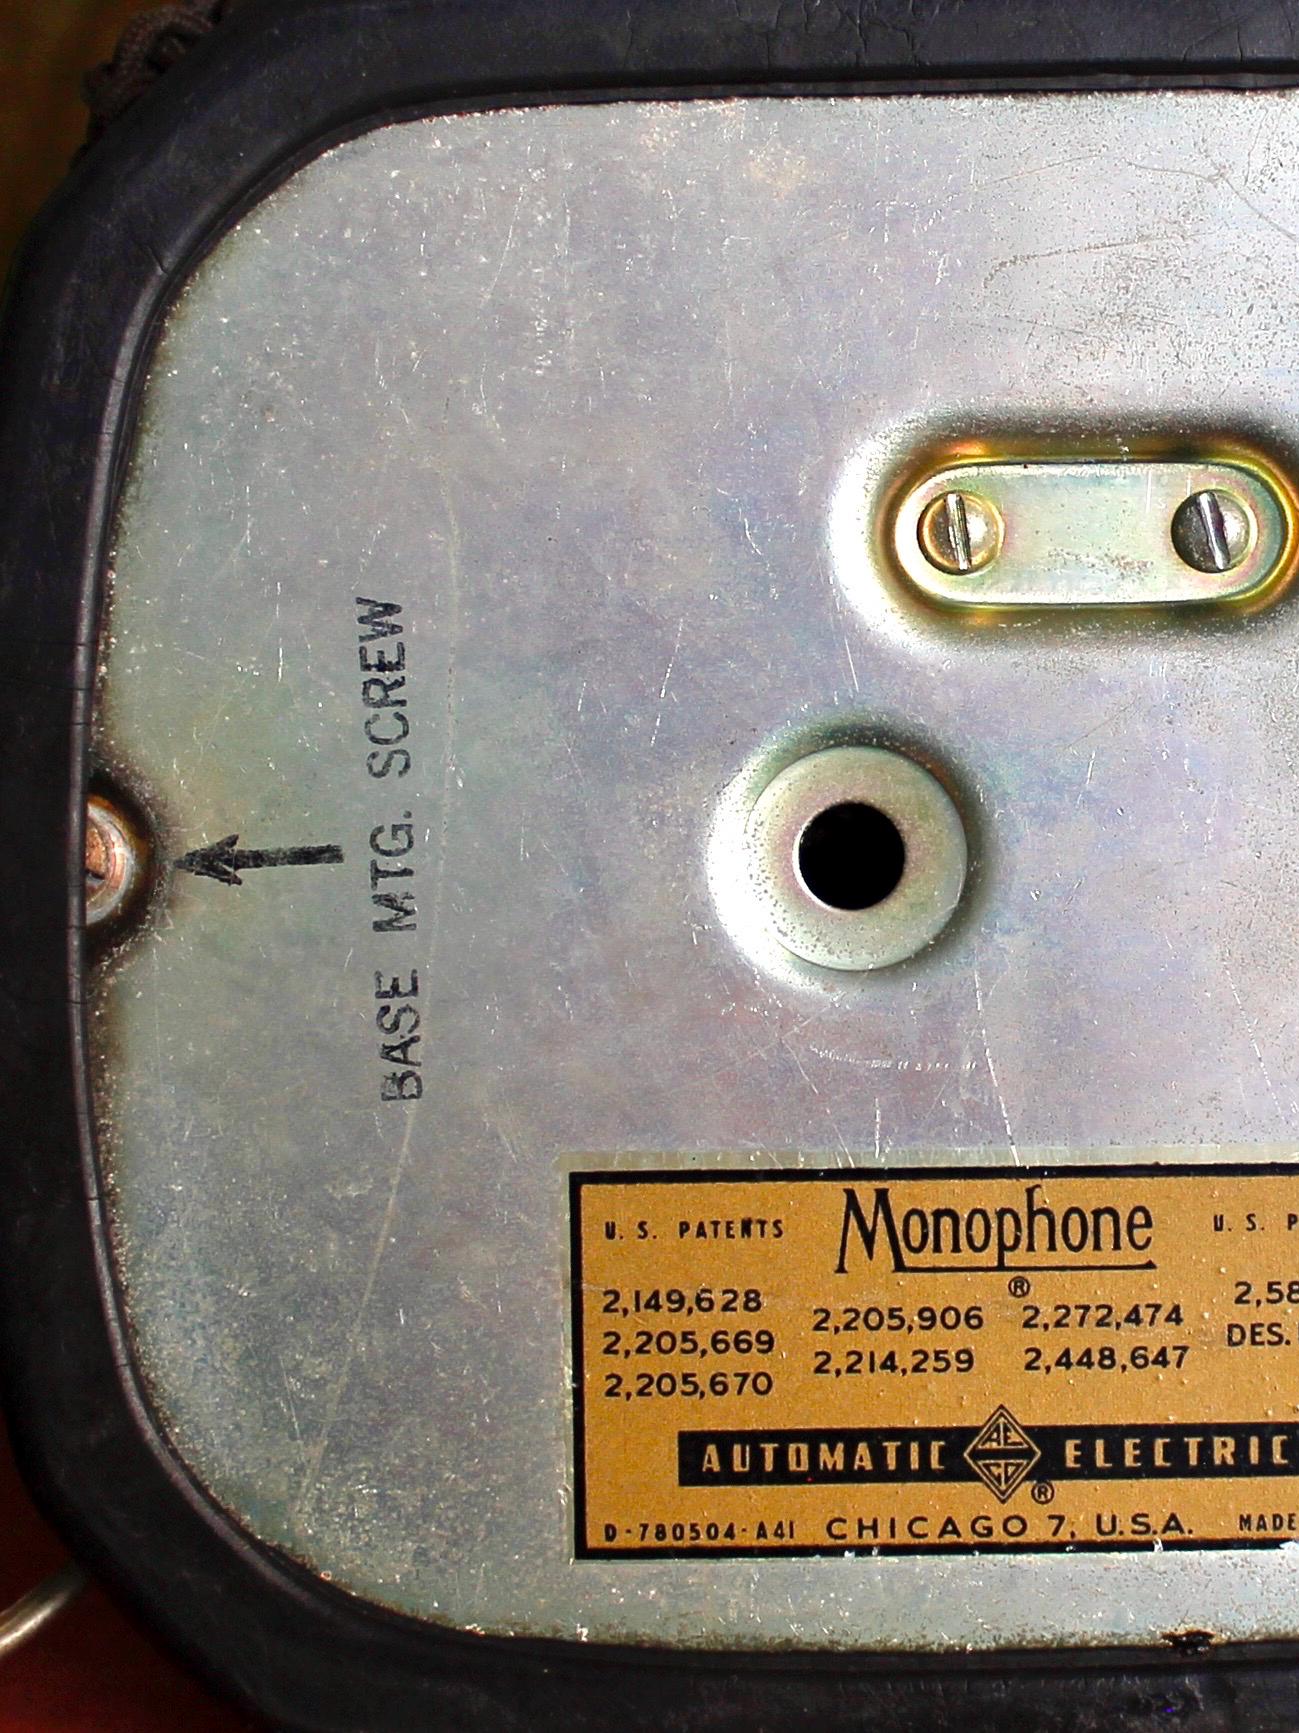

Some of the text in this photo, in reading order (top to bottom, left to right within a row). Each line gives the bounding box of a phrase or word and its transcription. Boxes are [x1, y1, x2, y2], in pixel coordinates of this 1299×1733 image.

[356, 595, 423, 1101] BASE MTG. SCREW
[604, 1218, 785, 1240] U. S. PATENTS
[834, 1184, 1156, 1273] Monophone
[1213, 1214, 1232, 1232] U.
[1246, 1213, 1265, 1231] S.
[601, 1288, 763, 1318] 2,149,628
[1021, 1303, 1185, 1331] 2,272,474
[812, 1305, 985, 1335] 2,205,906
[602, 1329, 776, 1359] 2,205,669
[1023, 1344, 1190, 1374] 2,448,647
[813, 1349, 975, 1377] 2,214,259
[603, 1371, 774, 1401] 2,205,670
[702, 1435, 1290, 1473] AUTOMATIC ELECTRIC
[826, 1514, 1027, 1540] CHICAGO
[1239, 1512, 1297, 1532] MADE
